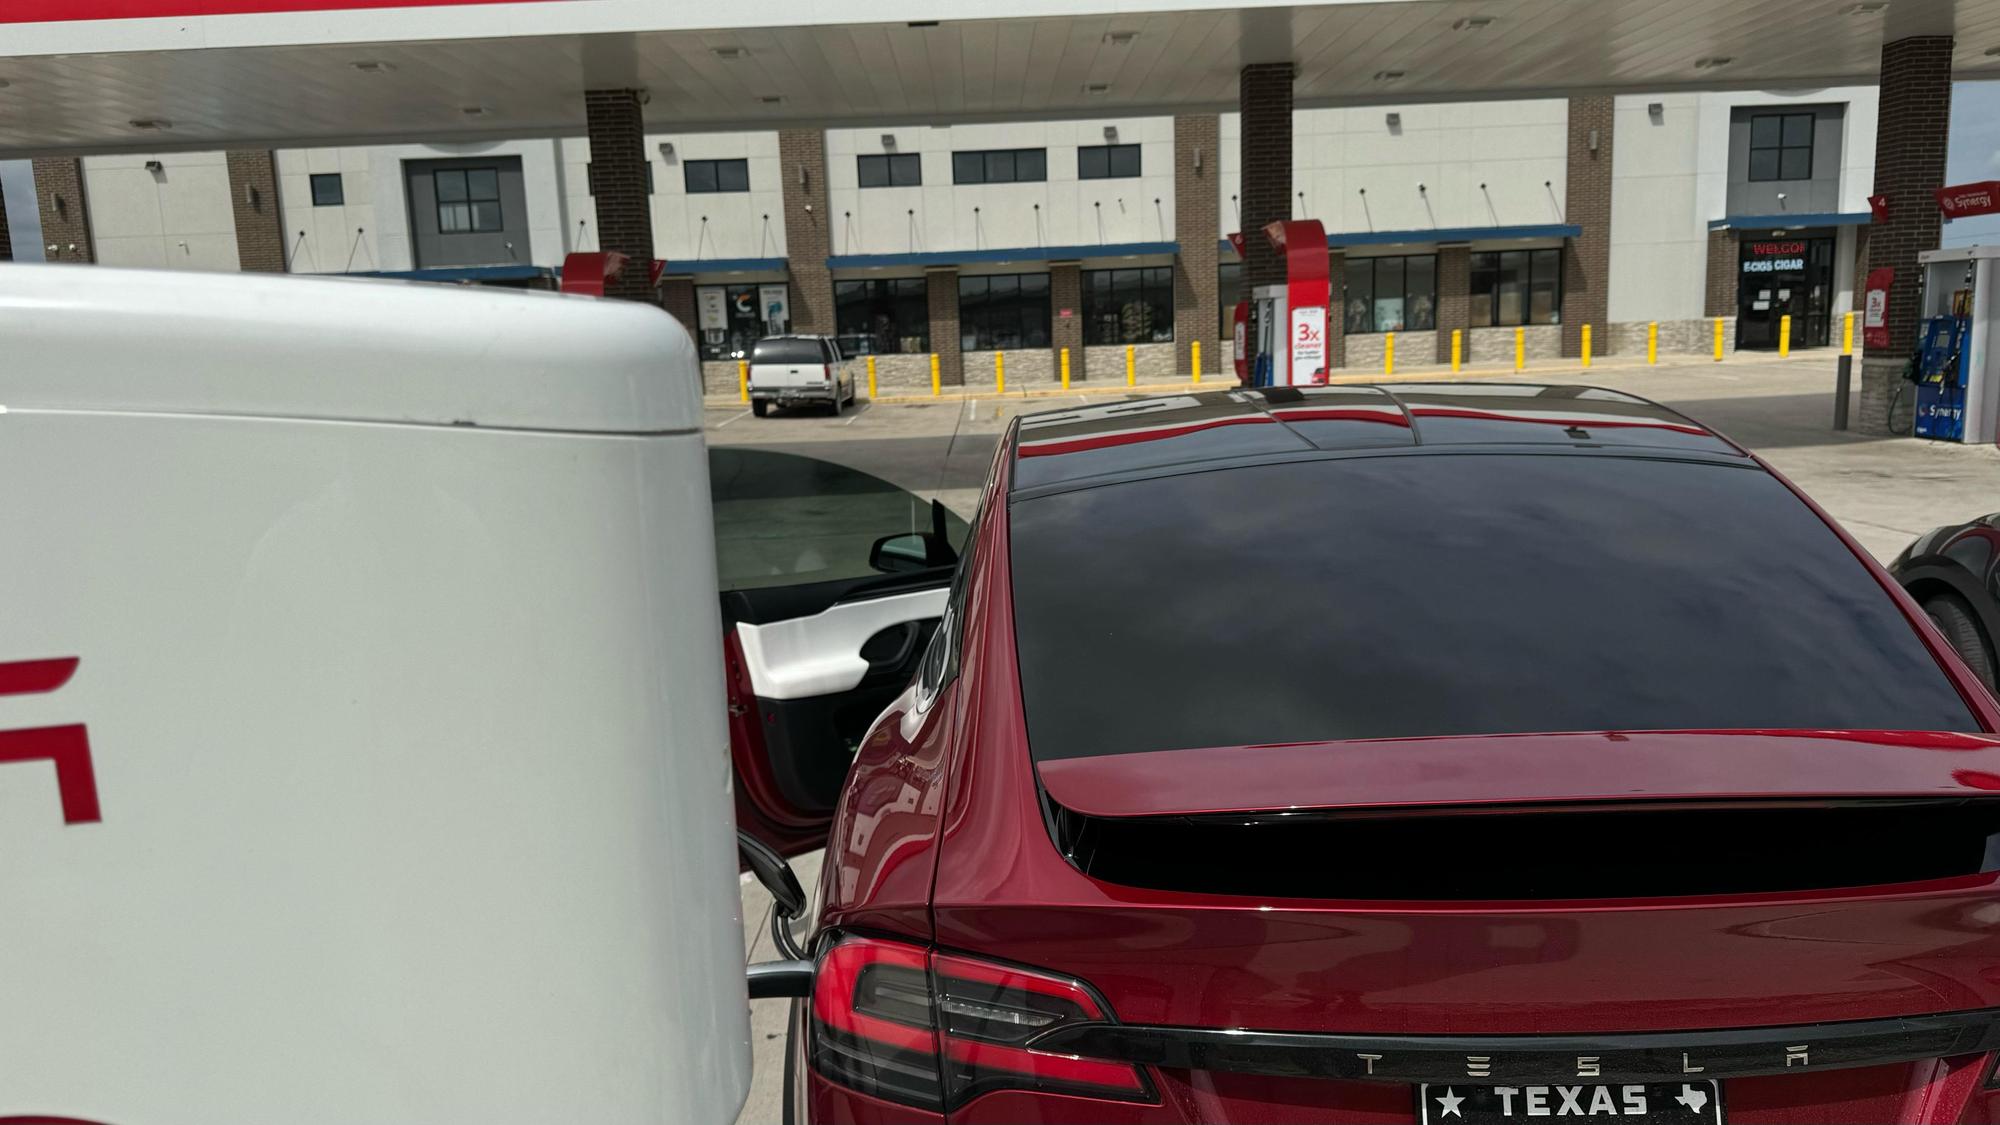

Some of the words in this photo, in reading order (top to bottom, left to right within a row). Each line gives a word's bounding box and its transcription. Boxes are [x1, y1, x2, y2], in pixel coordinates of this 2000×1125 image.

[1878, 197, 1886, 207] 4
[1954, 195, 1991, 210] Synergy
[1774, 258, 1804, 271] CIGAR
[1298, 323, 1320, 342] 3x
[1357, 1044, 1809, 1077] TESLA
[1494, 1085, 1648, 1116] TEXAS
